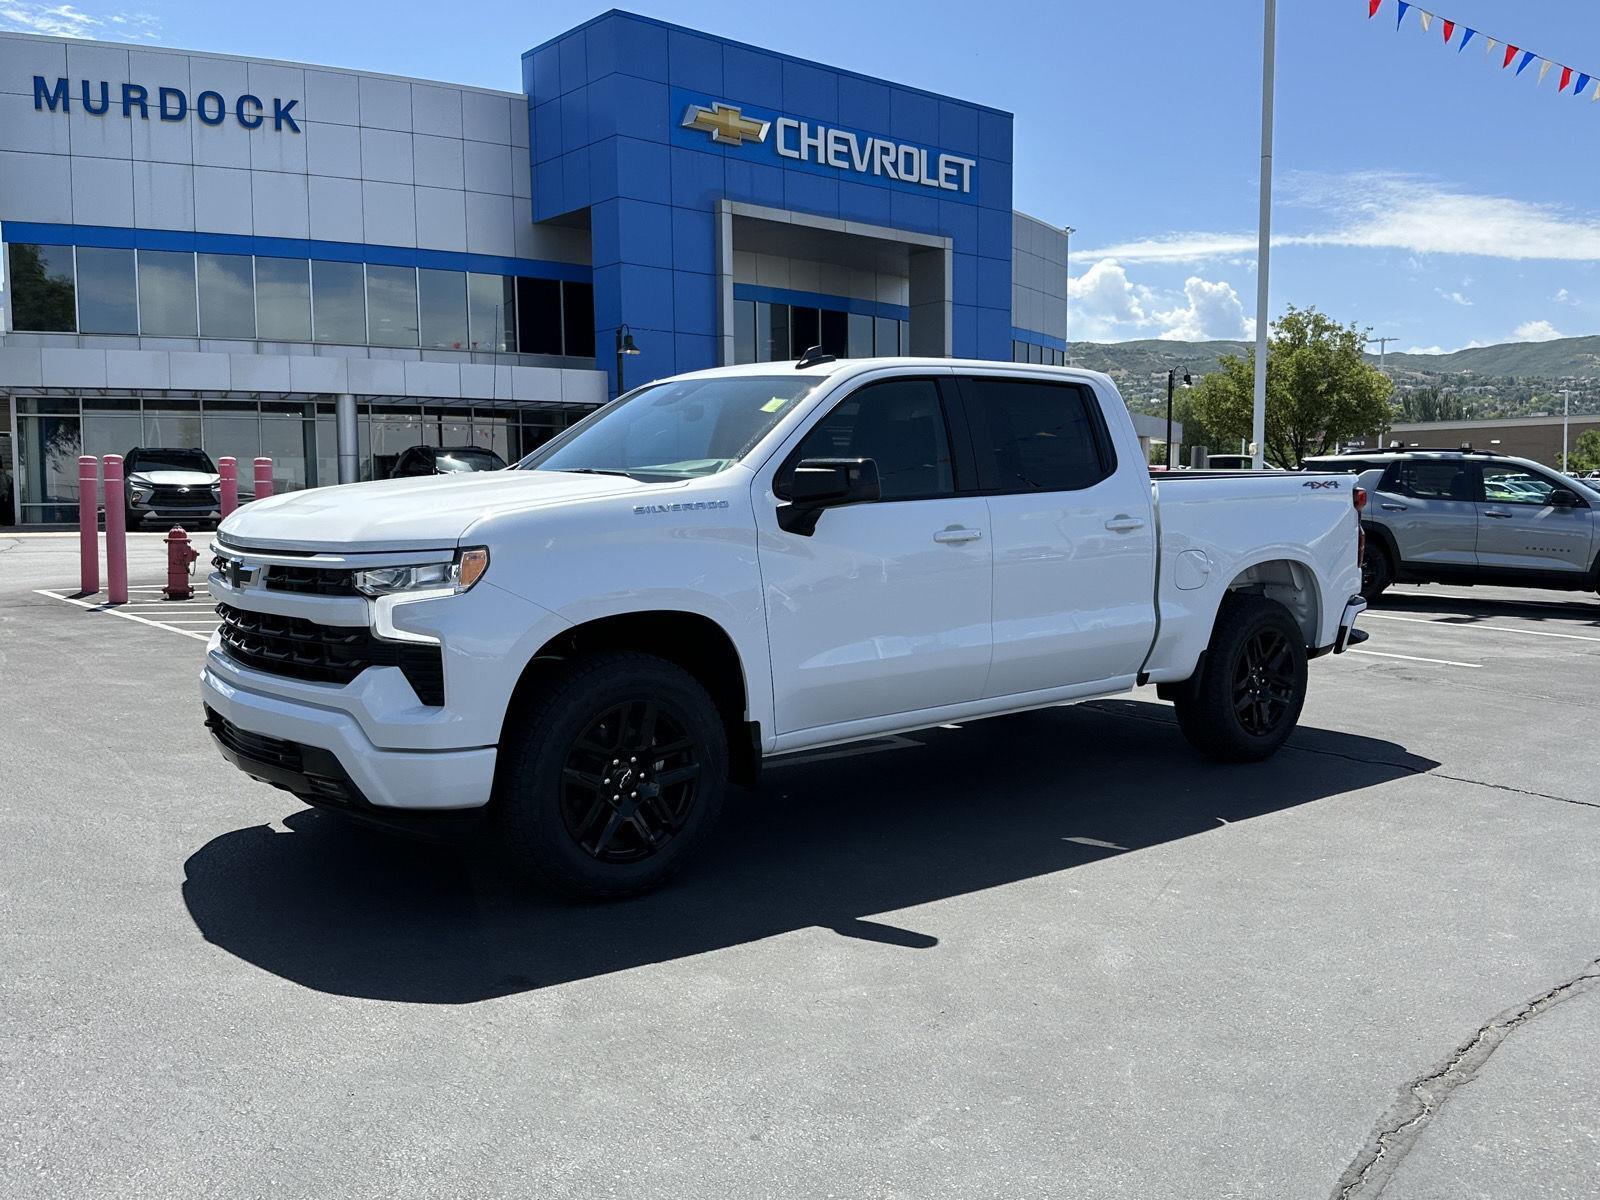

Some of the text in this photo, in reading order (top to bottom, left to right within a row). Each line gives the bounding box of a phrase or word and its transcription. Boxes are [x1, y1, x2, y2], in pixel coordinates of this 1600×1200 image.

[33, 75, 301, 133] MURDOCK
[775, 116, 977, 193] CHEVROLET
[633, 500, 729, 515] SILVERADO
